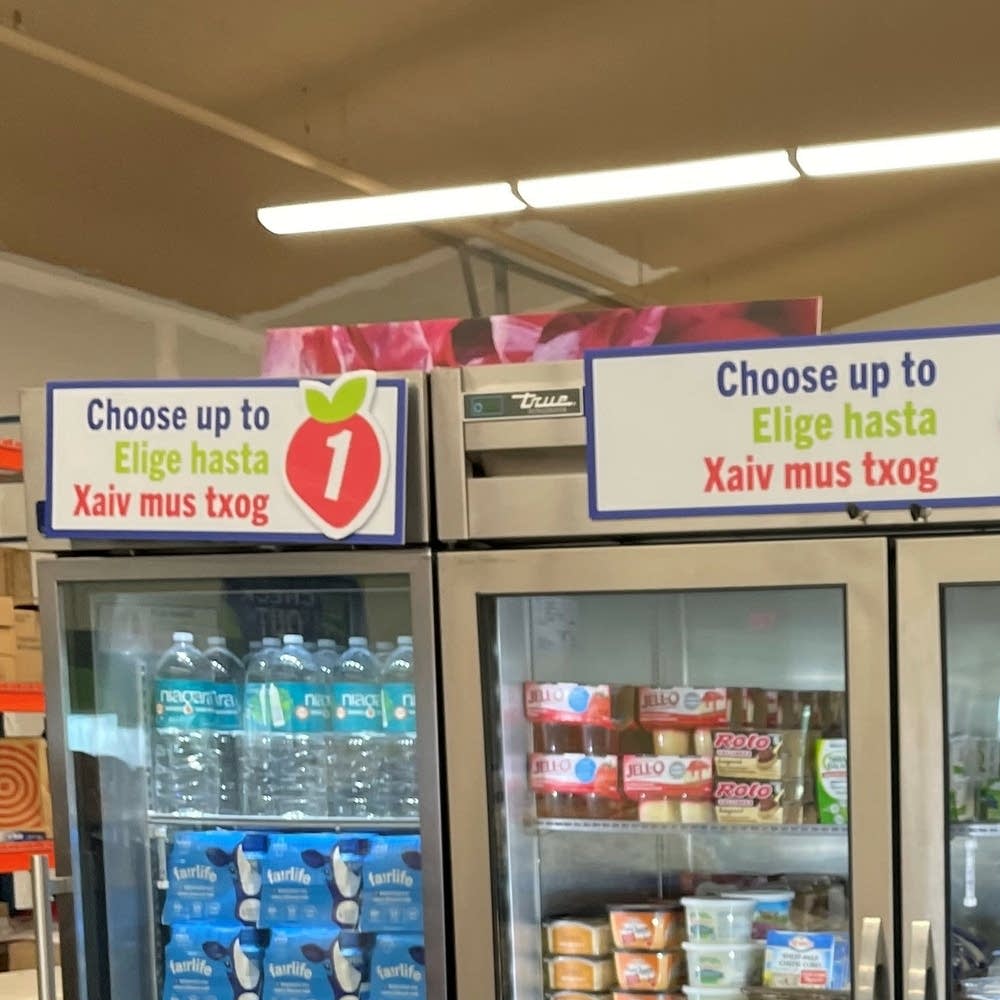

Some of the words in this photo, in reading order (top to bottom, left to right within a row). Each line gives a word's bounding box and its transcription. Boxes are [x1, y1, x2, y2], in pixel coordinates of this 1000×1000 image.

[717, 360, 838, 397] Choose
[849, 361, 891, 396] up
[902, 353, 937, 387] to
[87, 399, 187, 431] Choose
[197, 406, 232, 437] up
[242, 401, 270, 431] to
[752, 406, 833, 450] Elige
[843, 399, 938, 438] hasta
[115, 441, 181, 480] Elige
[190, 442, 269, 475] hasta
[324, 429, 353, 501] 1
[704, 455, 775, 493] Xaiv
[785, 458, 852, 490] mus
[865, 452, 939, 493] txog
[74, 484, 131, 517] Xaiv
[140, 491, 196, 518] mus
[206, 486, 270, 525] txog
[173, 865, 217, 882] fairlife
[267, 866, 311, 885] fairlife
[368, 868, 414, 887] fairlife
[170, 958, 213, 977] fairlife
[269, 961, 312, 981] fairlife
[377, 963, 422, 983] fairlife
